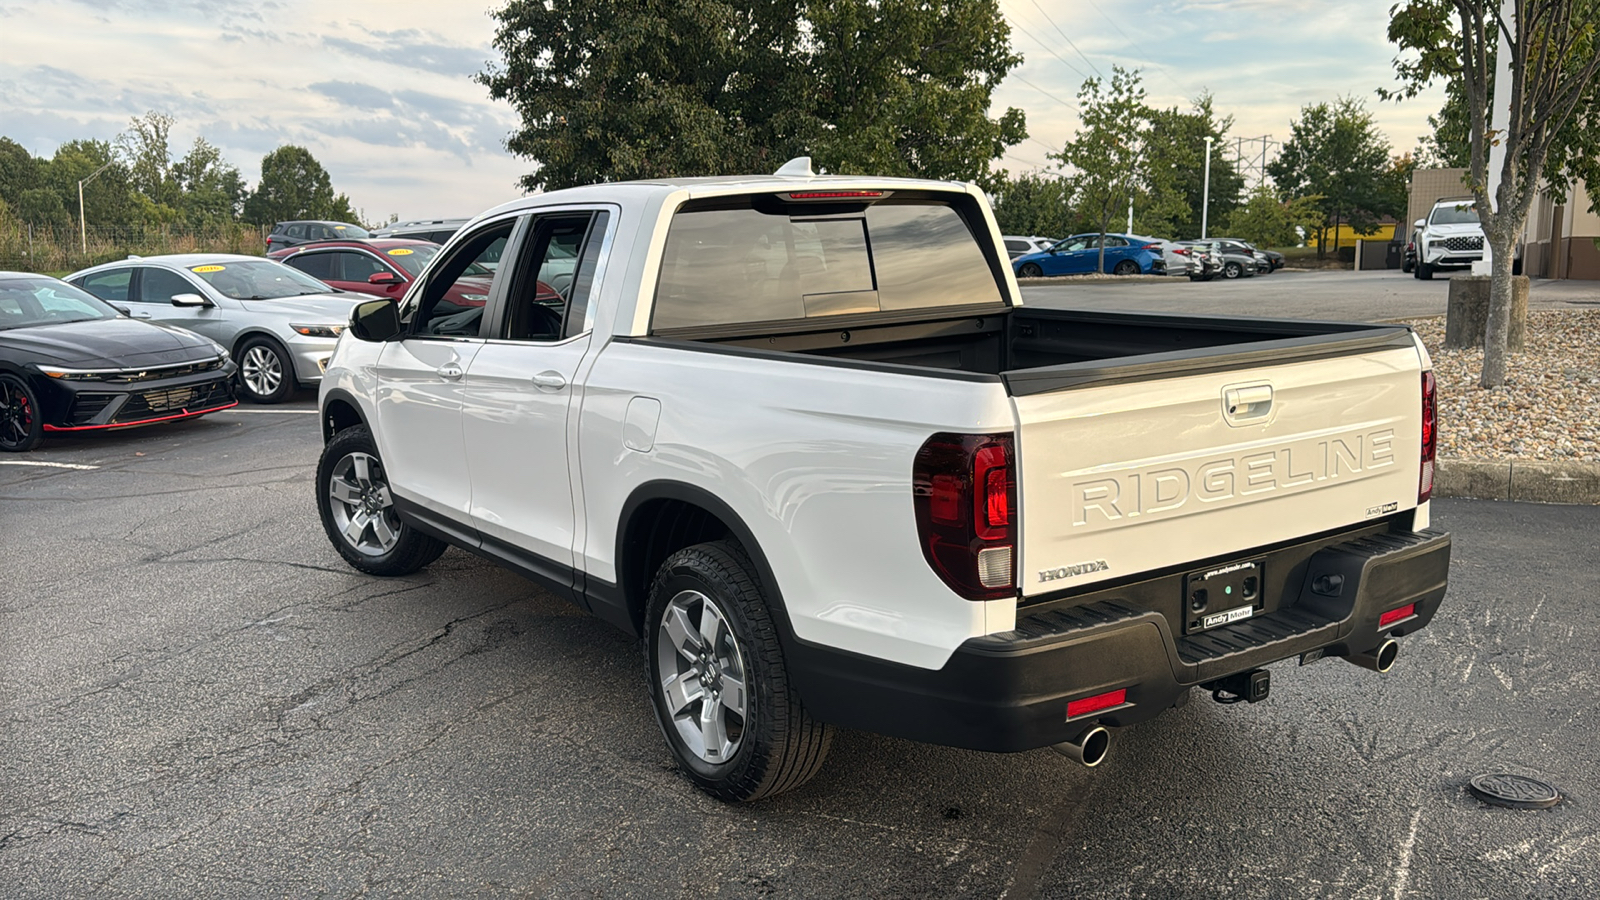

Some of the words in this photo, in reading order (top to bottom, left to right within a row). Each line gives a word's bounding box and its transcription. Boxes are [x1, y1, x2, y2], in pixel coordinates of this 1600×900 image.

[1072, 428, 1395, 526] RIDGELINE
[1366, 507, 1381, 516] Andy
[1037, 560, 1109, 583] HONDA
[1206, 614, 1228, 626] Andy
[1230, 609, 1251, 620] Mohr
